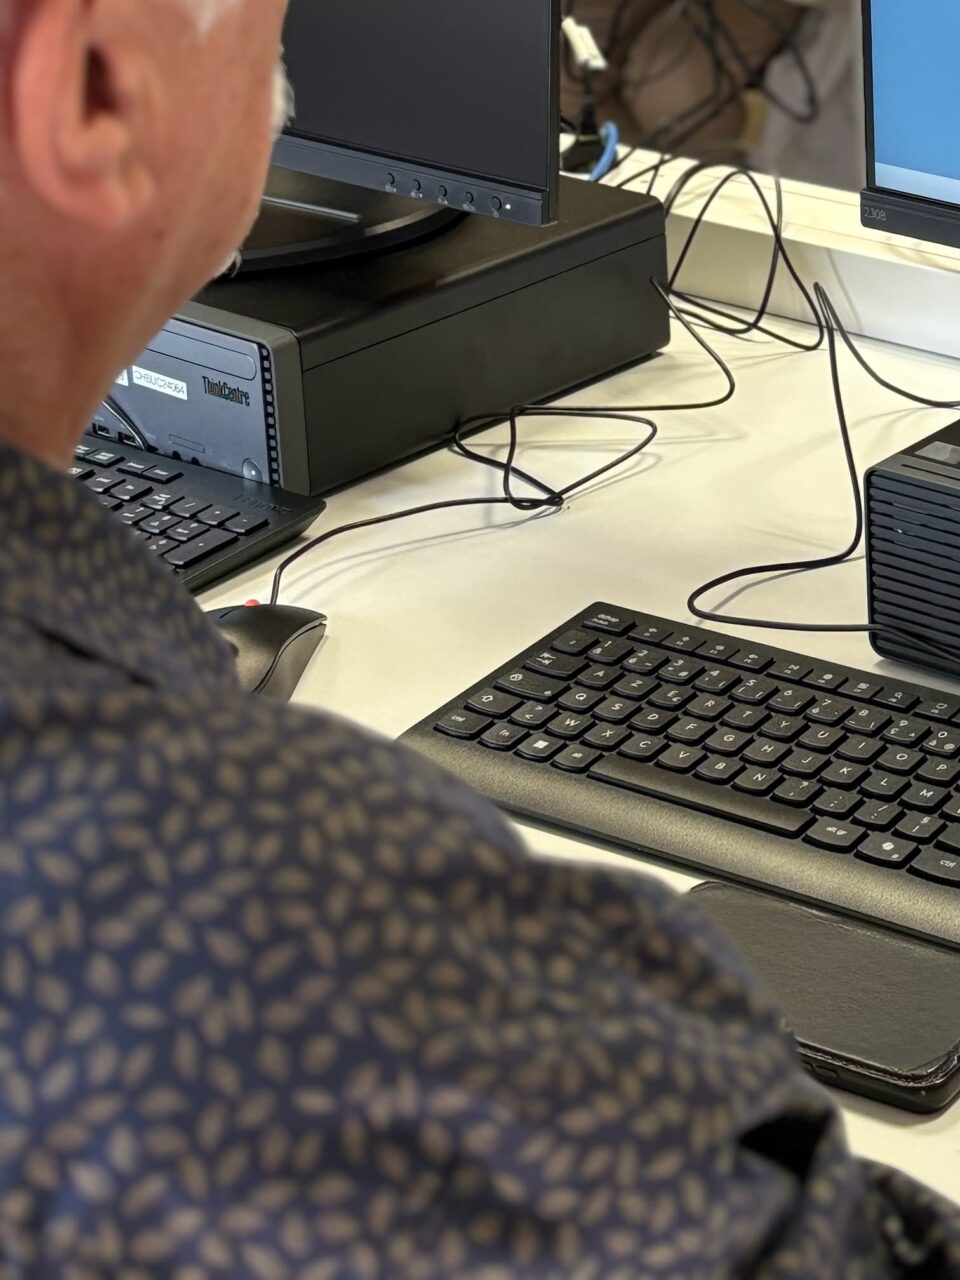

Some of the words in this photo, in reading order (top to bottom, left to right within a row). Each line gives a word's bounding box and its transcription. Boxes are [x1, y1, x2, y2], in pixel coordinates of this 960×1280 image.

[201, 375, 250, 407] ThinkCentre
[575, 692, 587, 700] Q
[565, 718, 581, 726] W
[601, 730, 615, 738] X
[817, 731, 829, 739] U
[761, 745, 774, 753] H
[679, 751, 690, 759] V
[896, 753, 908, 761] O
[714, 762, 726, 770] B
[839, 766, 852, 774] K
[752, 773, 766, 781] N
[919, 789, 933, 798] M
[940, 859, 956, 868] ctrl
